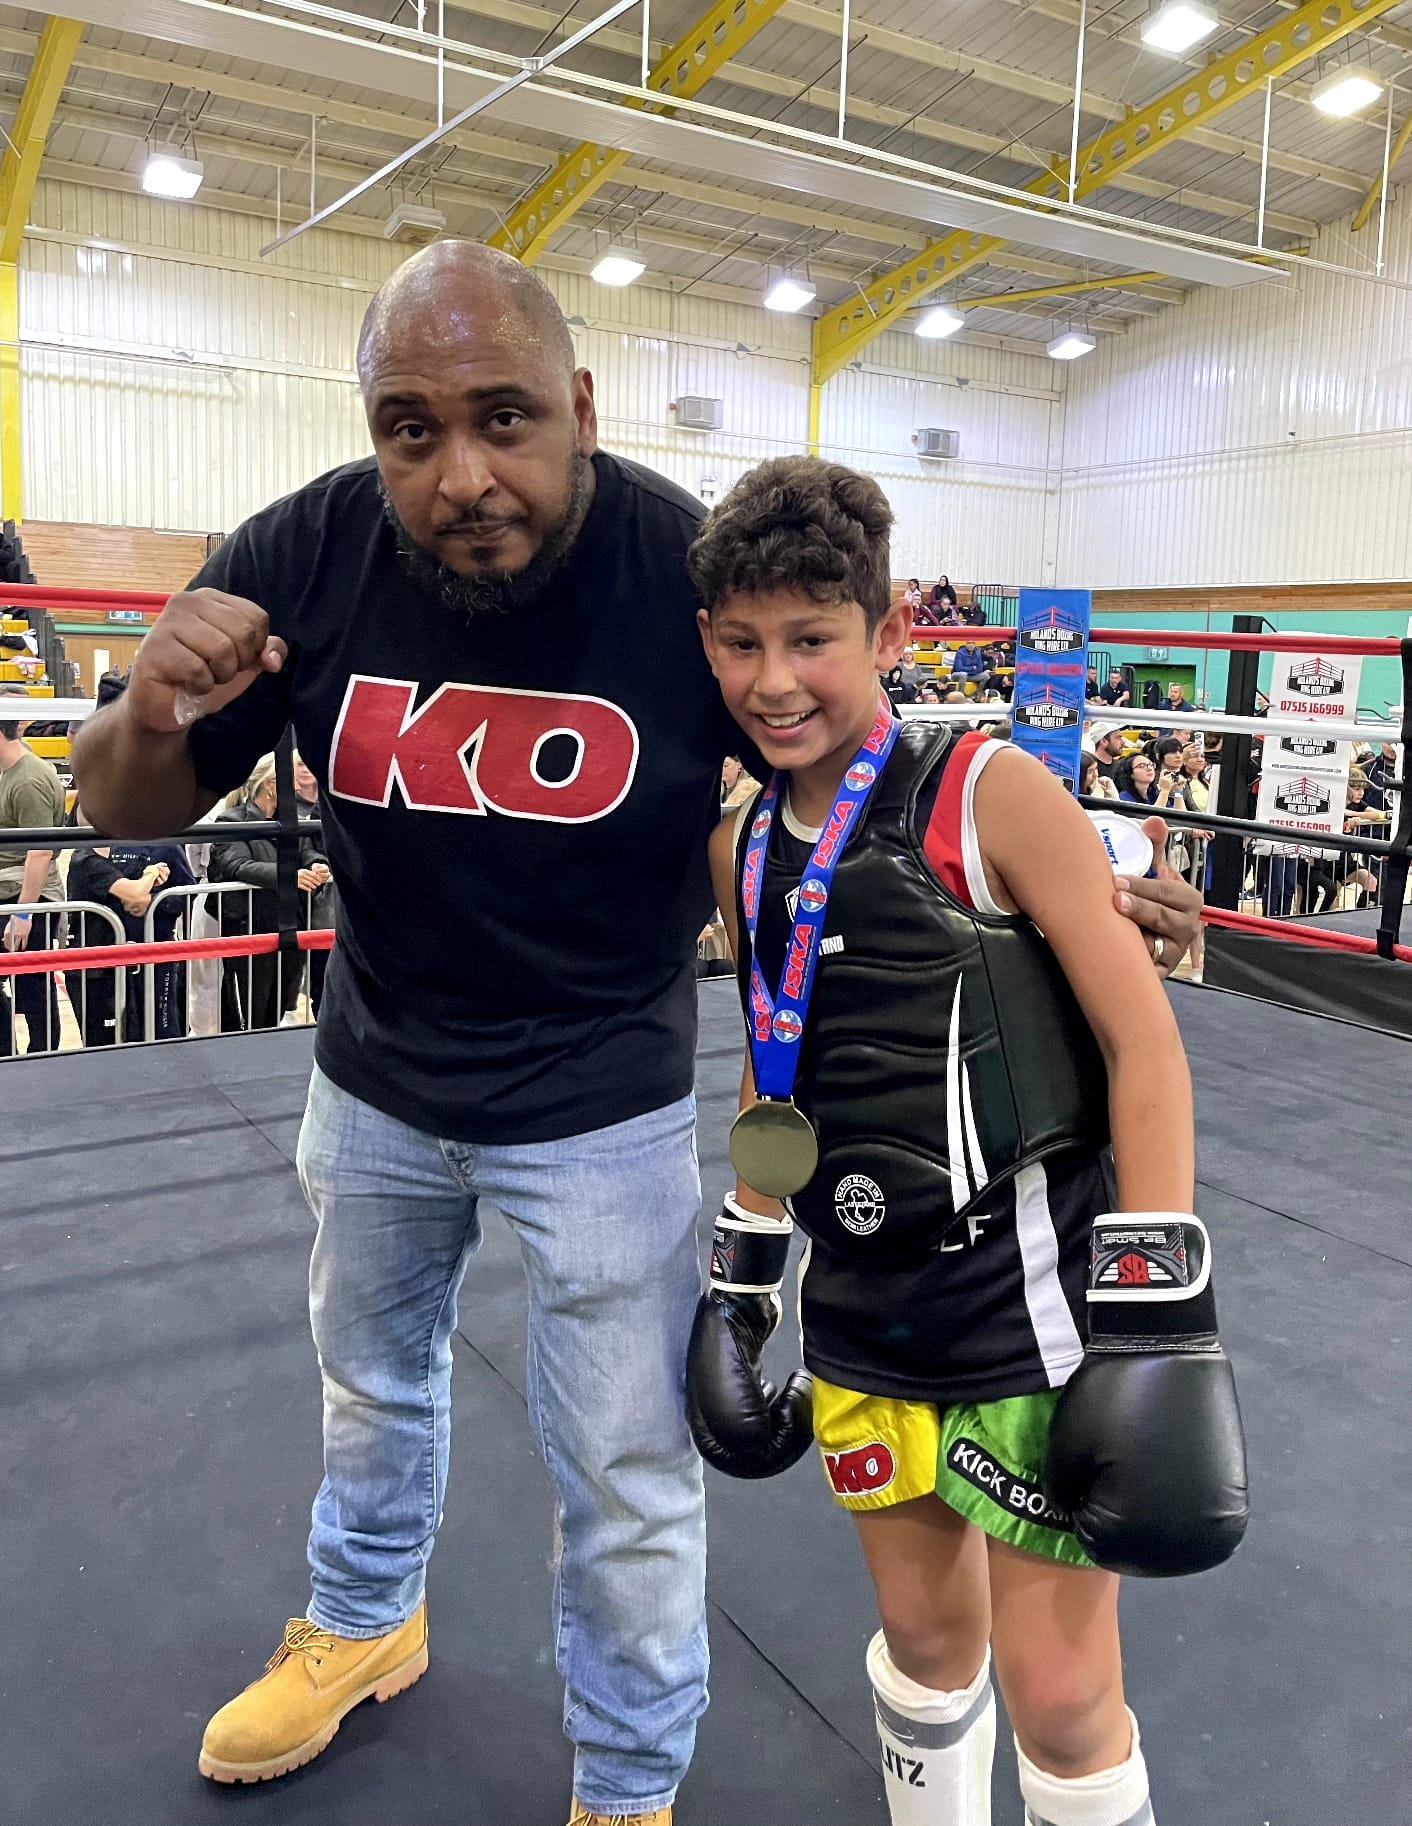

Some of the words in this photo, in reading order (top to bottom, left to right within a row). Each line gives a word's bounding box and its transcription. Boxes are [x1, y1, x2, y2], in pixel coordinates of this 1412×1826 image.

[1281, 700, 1307, 713] 07515
[1309, 702, 1345, 716] 166999
[328, 673, 640, 824] KO
[813, 801, 853, 869] ISKA
[1101, 828, 1119, 865] Vsport
[743, 848, 760, 918] ISKA
[783, 923, 813, 1000] ISKA
[823, 1440, 897, 1496] KO
[953, 1443, 1007, 1497] KICK
